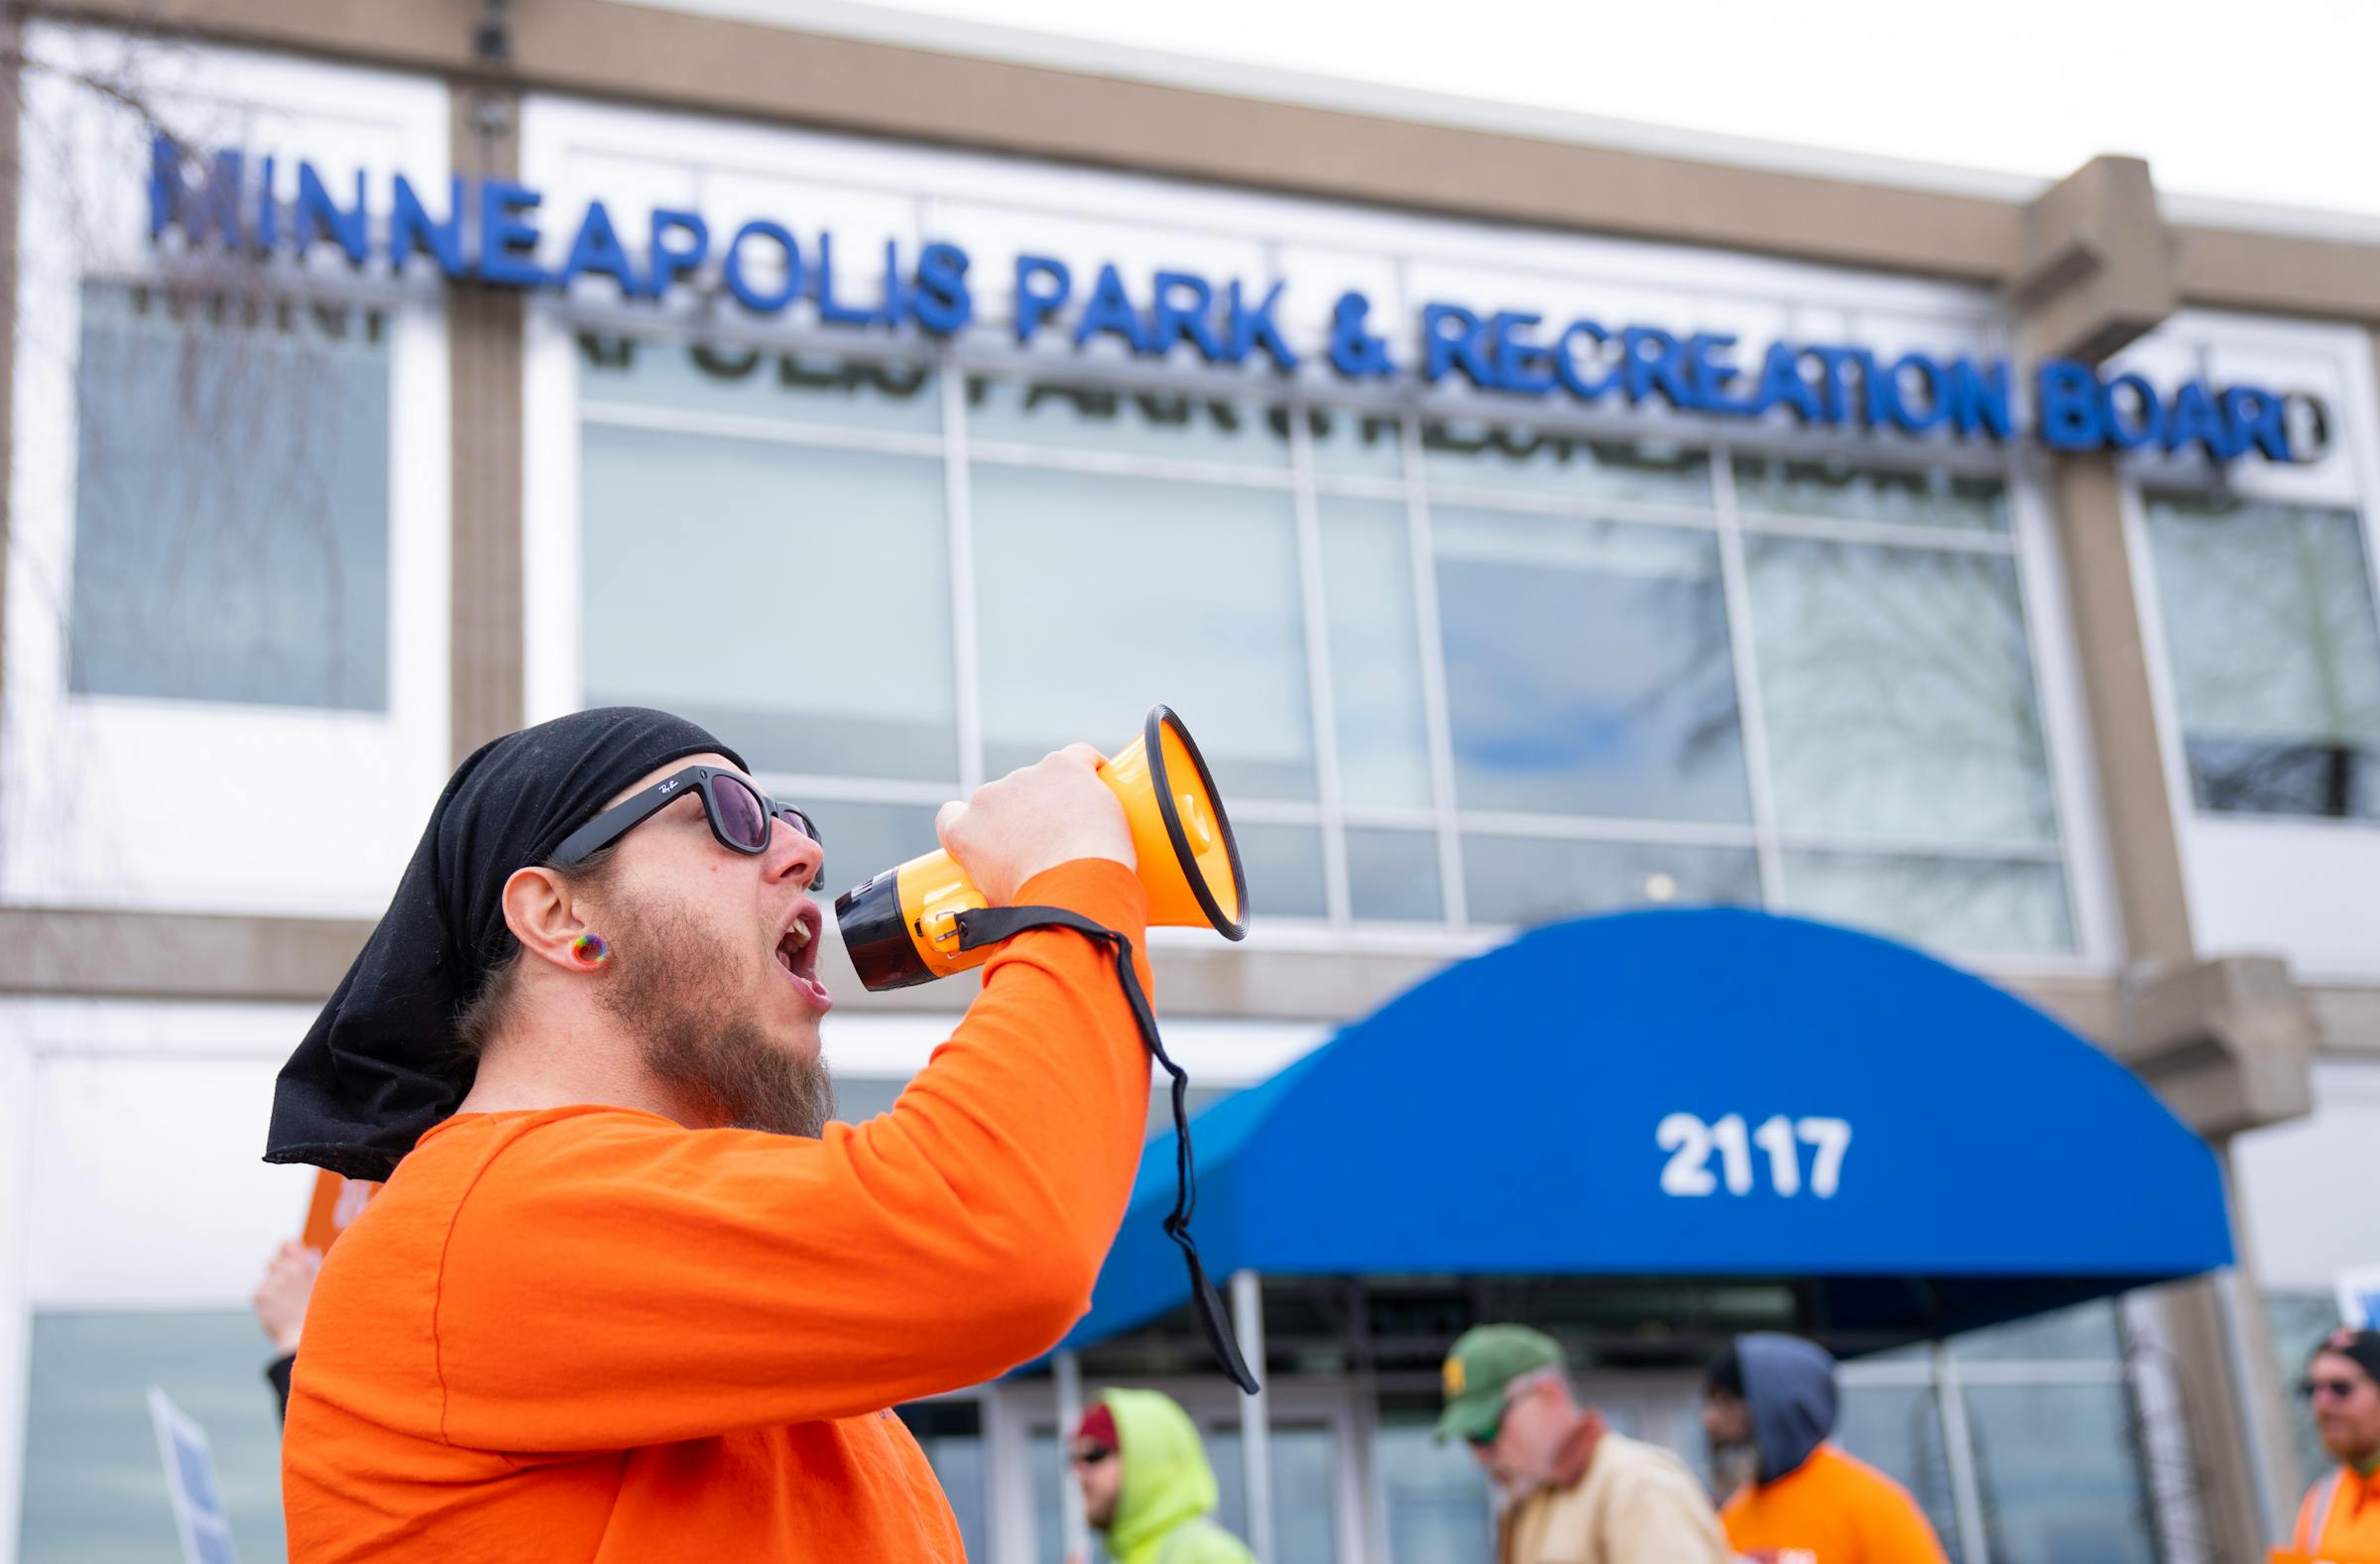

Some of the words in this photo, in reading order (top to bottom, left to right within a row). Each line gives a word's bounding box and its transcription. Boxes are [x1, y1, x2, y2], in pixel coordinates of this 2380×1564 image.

[149, 132, 971, 335] MINNEAPOLIS
[1013, 254, 1296, 371] PARK
[1329, 292, 1398, 376] &
[1424, 303, 2013, 439] RECREATION
[2038, 358, 2330, 463] BOARD
[1655, 1111, 1852, 1200] 2117
